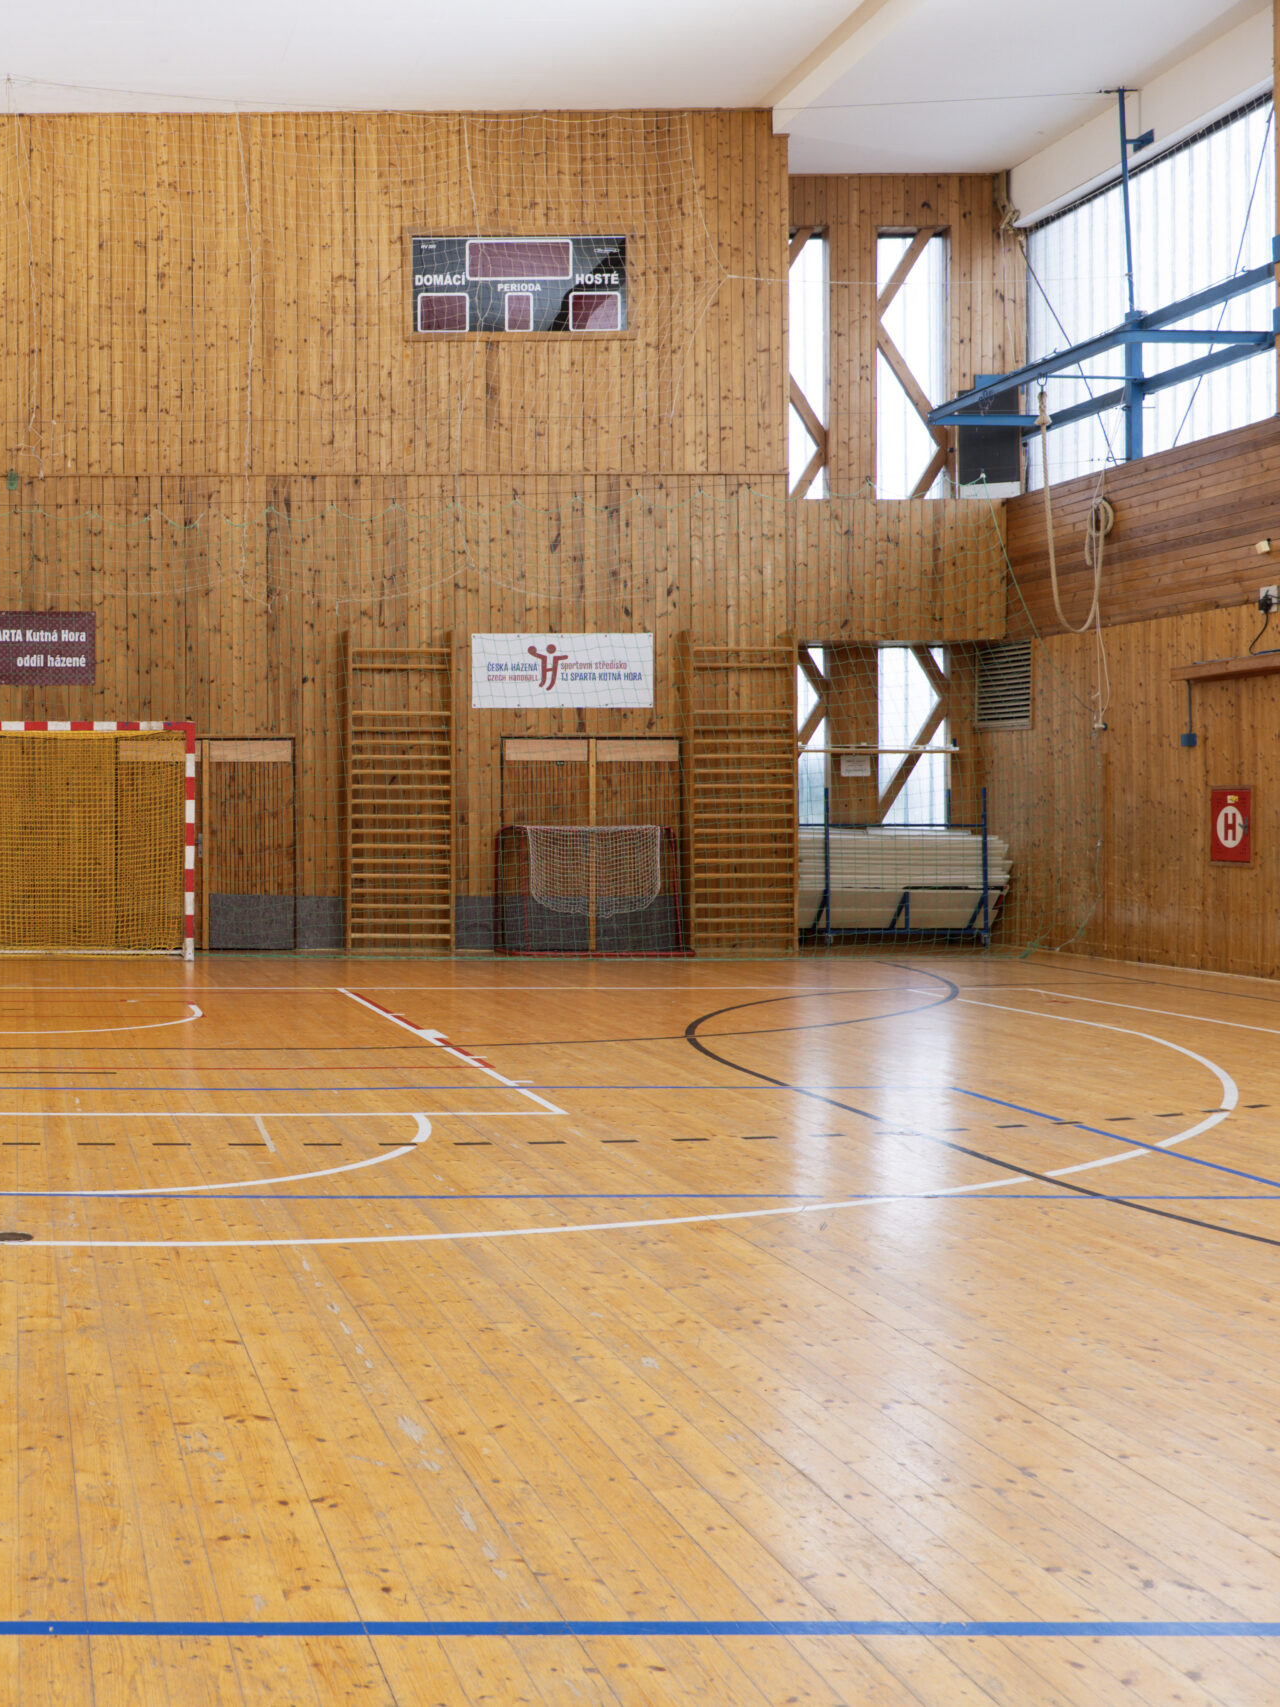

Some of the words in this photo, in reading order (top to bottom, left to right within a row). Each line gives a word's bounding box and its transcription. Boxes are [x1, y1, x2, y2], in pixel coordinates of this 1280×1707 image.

[415, 272, 466, 286] DOMÁCÍ
[575, 271, 619, 285] HOSTÉ
[497, 283, 541, 292] PERIODA
[26, 630, 58, 642] Kutná
[61, 630, 86, 642] Hora
[17, 654, 43, 667] oddíl
[47, 654, 86, 667] házené
[487, 662, 508, 671] ČESKÁ
[511, 661, 538, 671] HÁZENÁ
[561, 673, 569, 681] TJ
[571, 673, 596, 681] SPARTA
[598, 671, 621, 681] KUTNÁ
[623, 672, 642, 681] HORA
[1224, 812, 1237, 841] H
